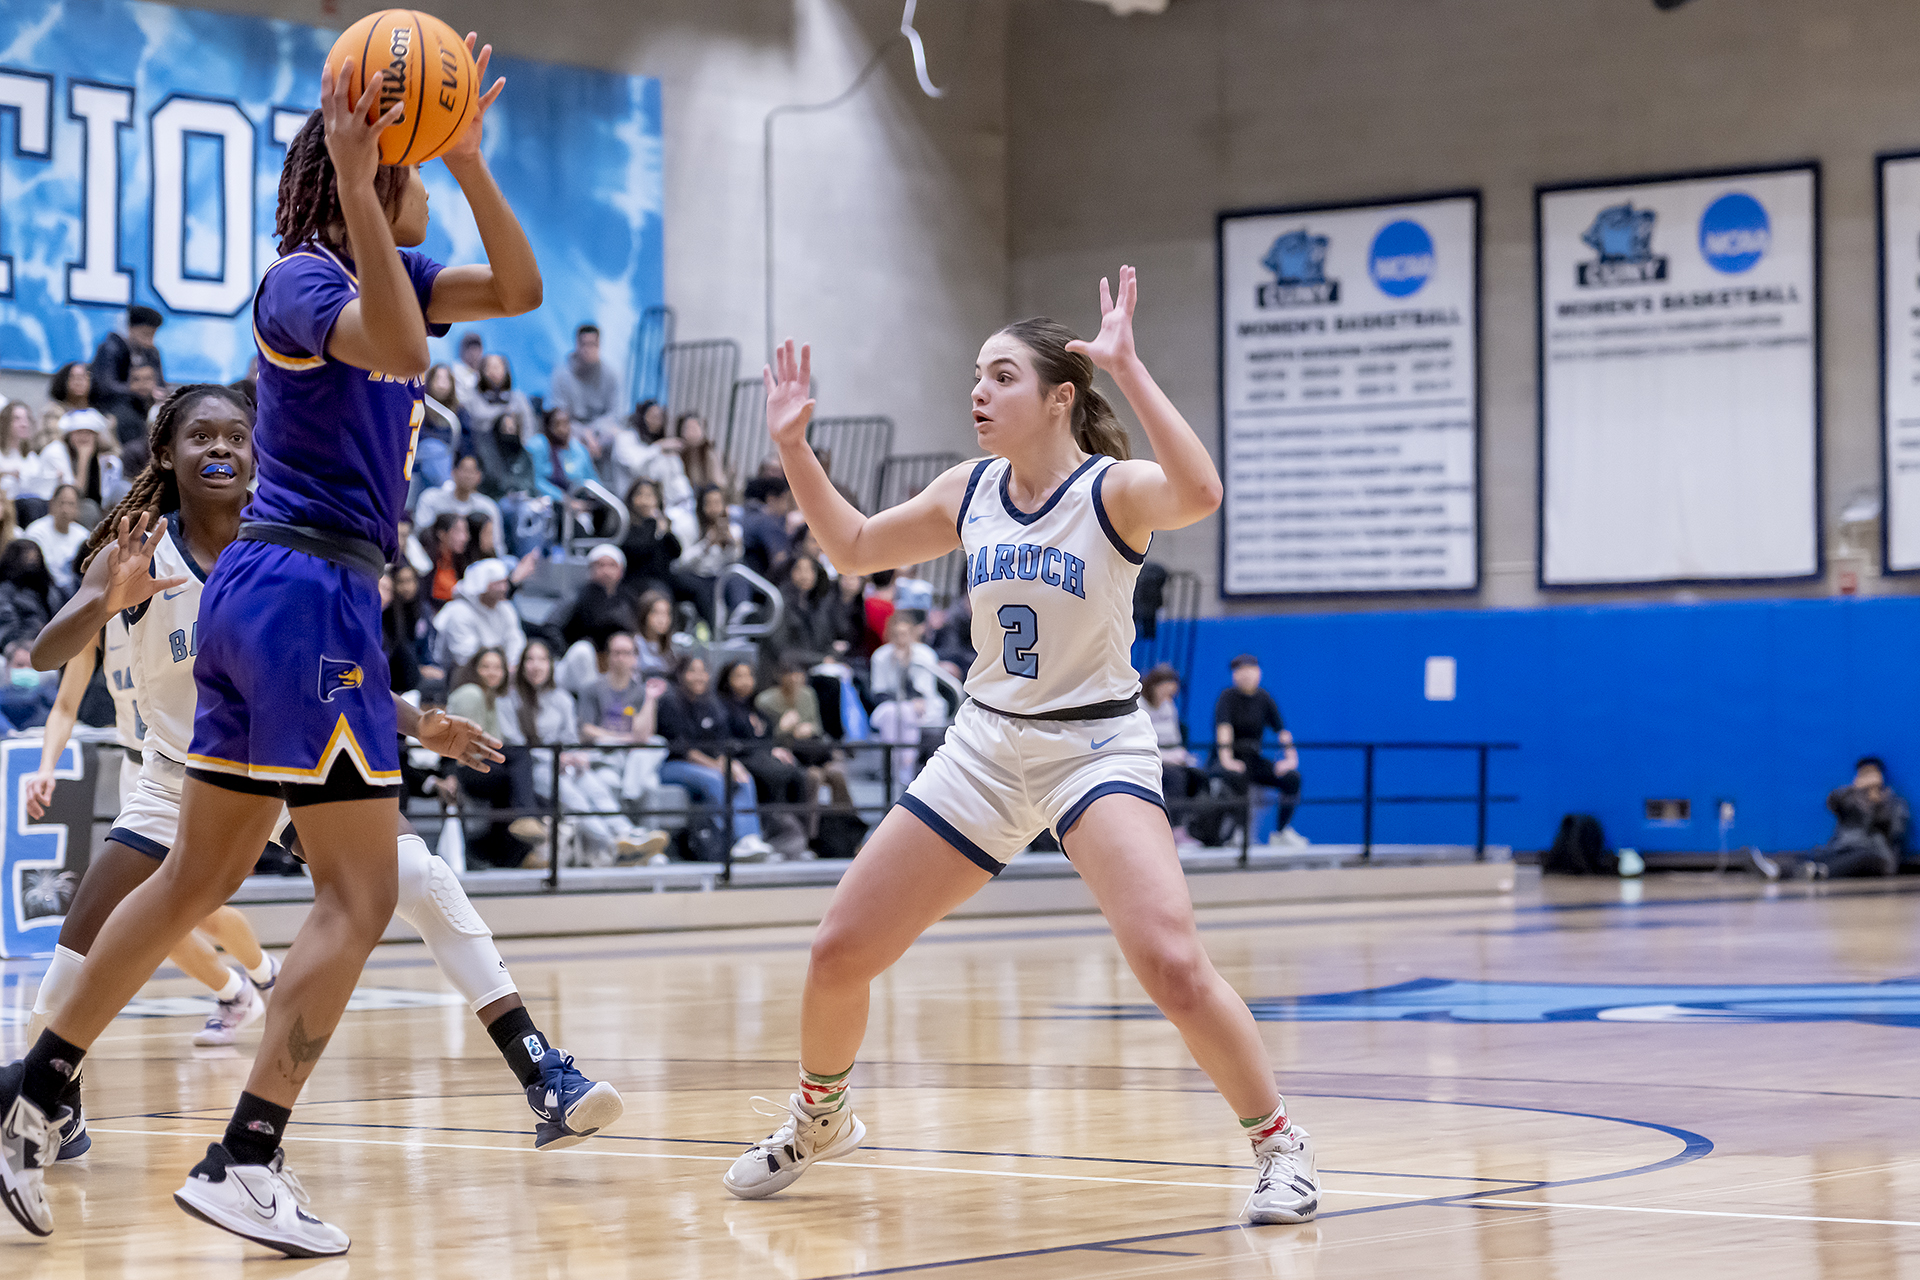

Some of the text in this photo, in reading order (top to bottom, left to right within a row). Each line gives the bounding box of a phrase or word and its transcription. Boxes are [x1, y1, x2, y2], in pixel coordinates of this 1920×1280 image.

[0, 66, 310, 318] IO
[1237, 307, 1461, 337] WOMEN'S BASKETBALL
[1556, 284, 1800, 320] WOMEN'S BASKETBALL
[997, 604, 1039, 680] 2
